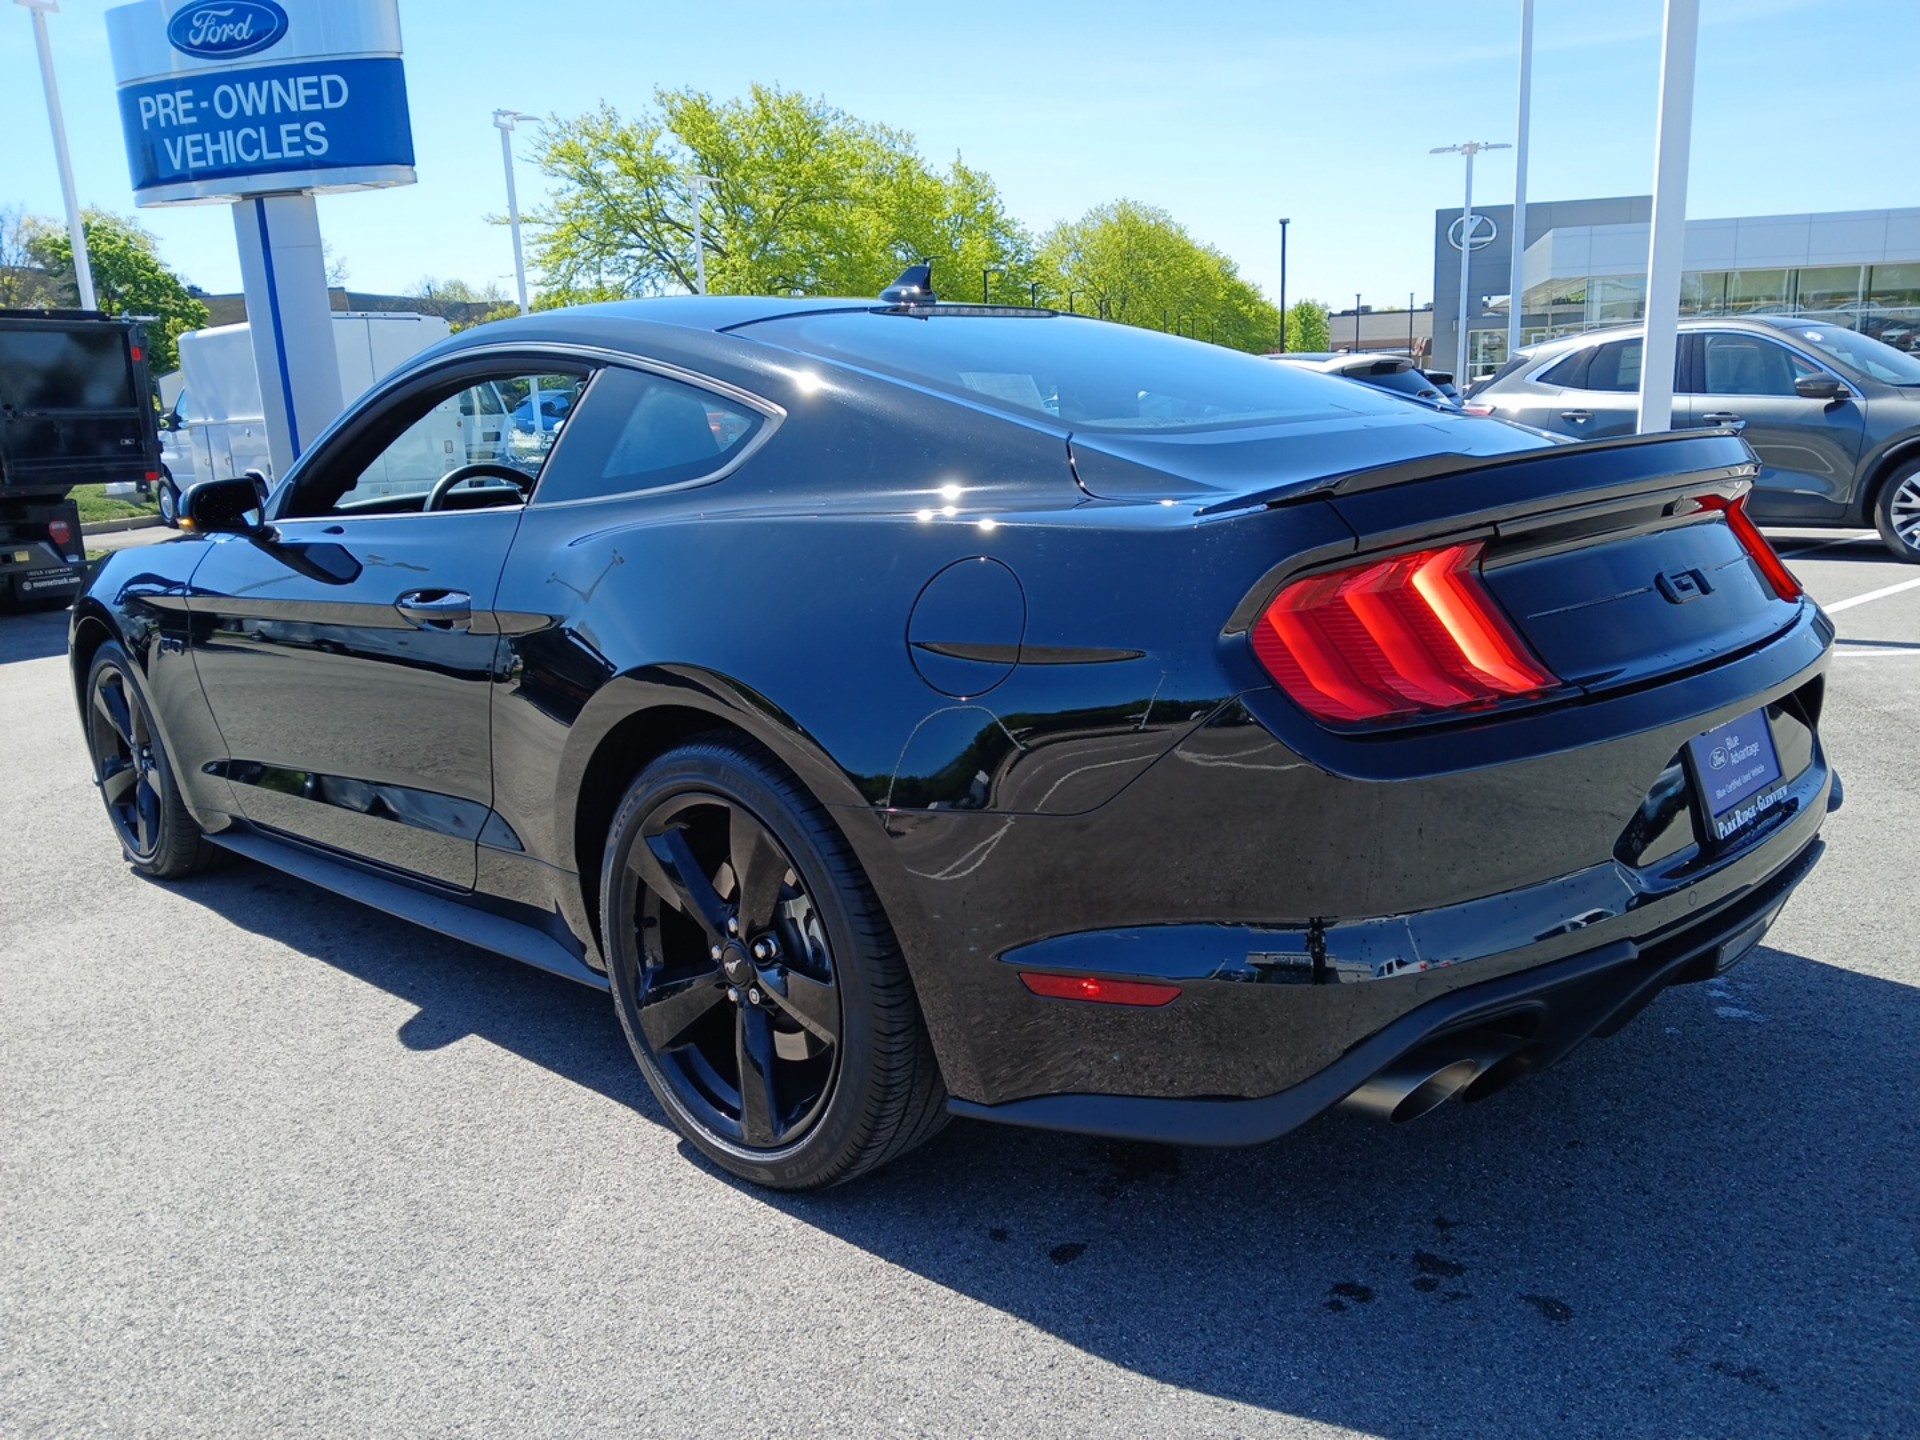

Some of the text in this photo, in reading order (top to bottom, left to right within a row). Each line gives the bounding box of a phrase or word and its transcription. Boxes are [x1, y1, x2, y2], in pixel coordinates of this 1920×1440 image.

[188, 7, 255, 46] Ford
[138, 74, 349, 130] PRE-OWNED
[164, 121, 329, 171] VEHICLES
[1654, 568, 1715, 605] GT
